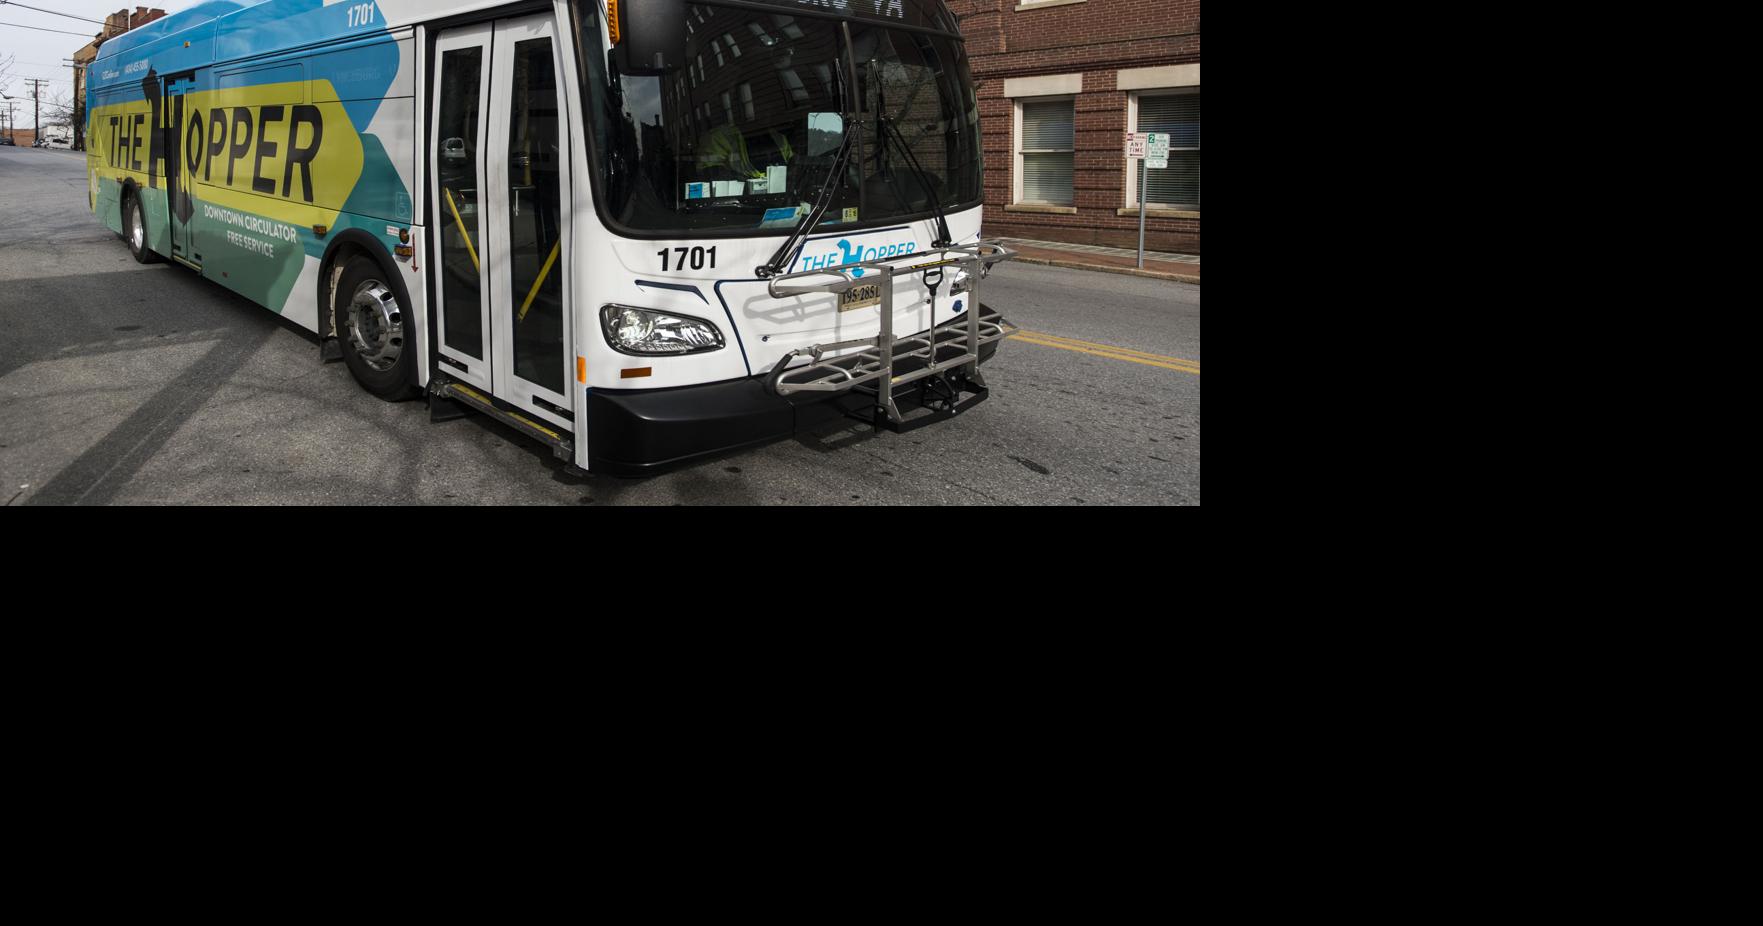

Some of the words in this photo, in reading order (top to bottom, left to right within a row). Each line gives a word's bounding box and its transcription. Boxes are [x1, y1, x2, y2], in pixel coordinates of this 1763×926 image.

[347, 1, 374, 27] 1701
[110, 115, 144, 171] THE
[204, 205, 244, 227] DOWNTOWN
[245, 215, 297, 243] CIRCULATOR
[227, 230, 243, 247] FREE
[244, 236, 274, 258] SERVICE
[657, 246, 716, 271] 1701
[803, 252, 837, 272] THE
